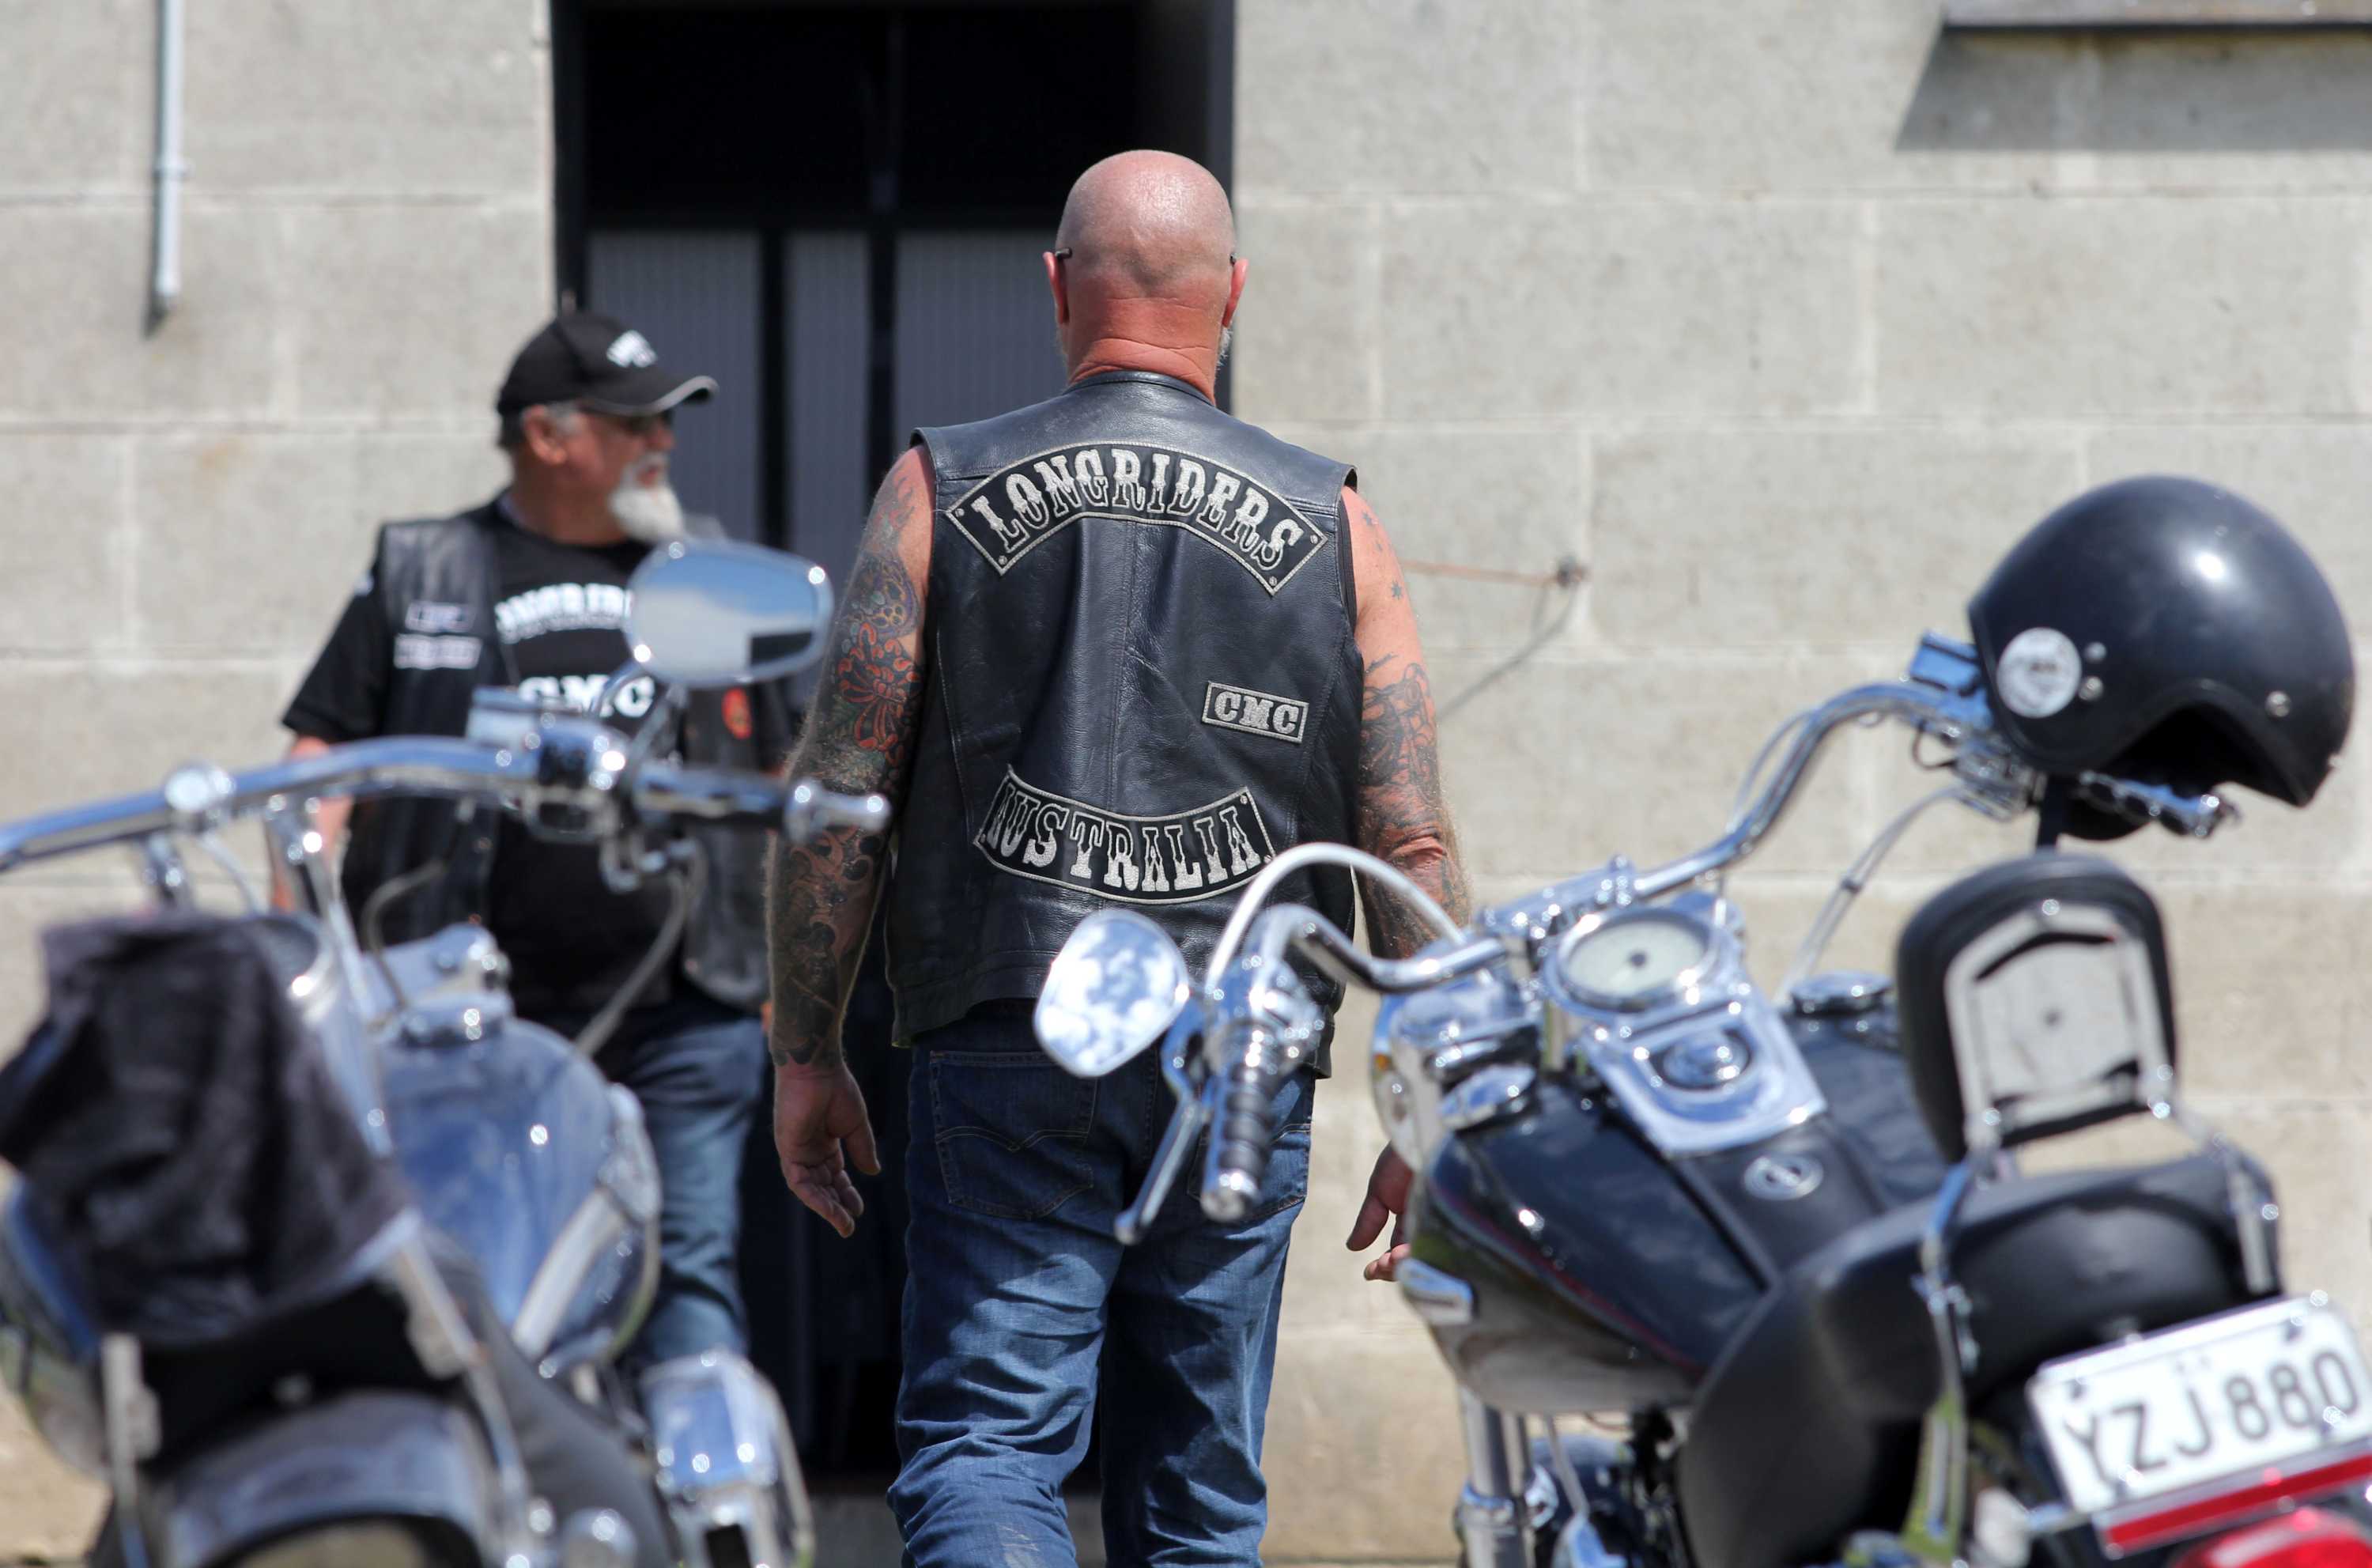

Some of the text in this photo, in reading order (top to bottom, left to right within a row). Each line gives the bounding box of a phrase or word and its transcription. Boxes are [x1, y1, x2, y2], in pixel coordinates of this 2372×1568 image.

[971, 448, 1304, 570] LONGRIDERS
[1214, 691, 1298, 734] CMC
[987, 783, 1261, 892] AUSTRALIA
